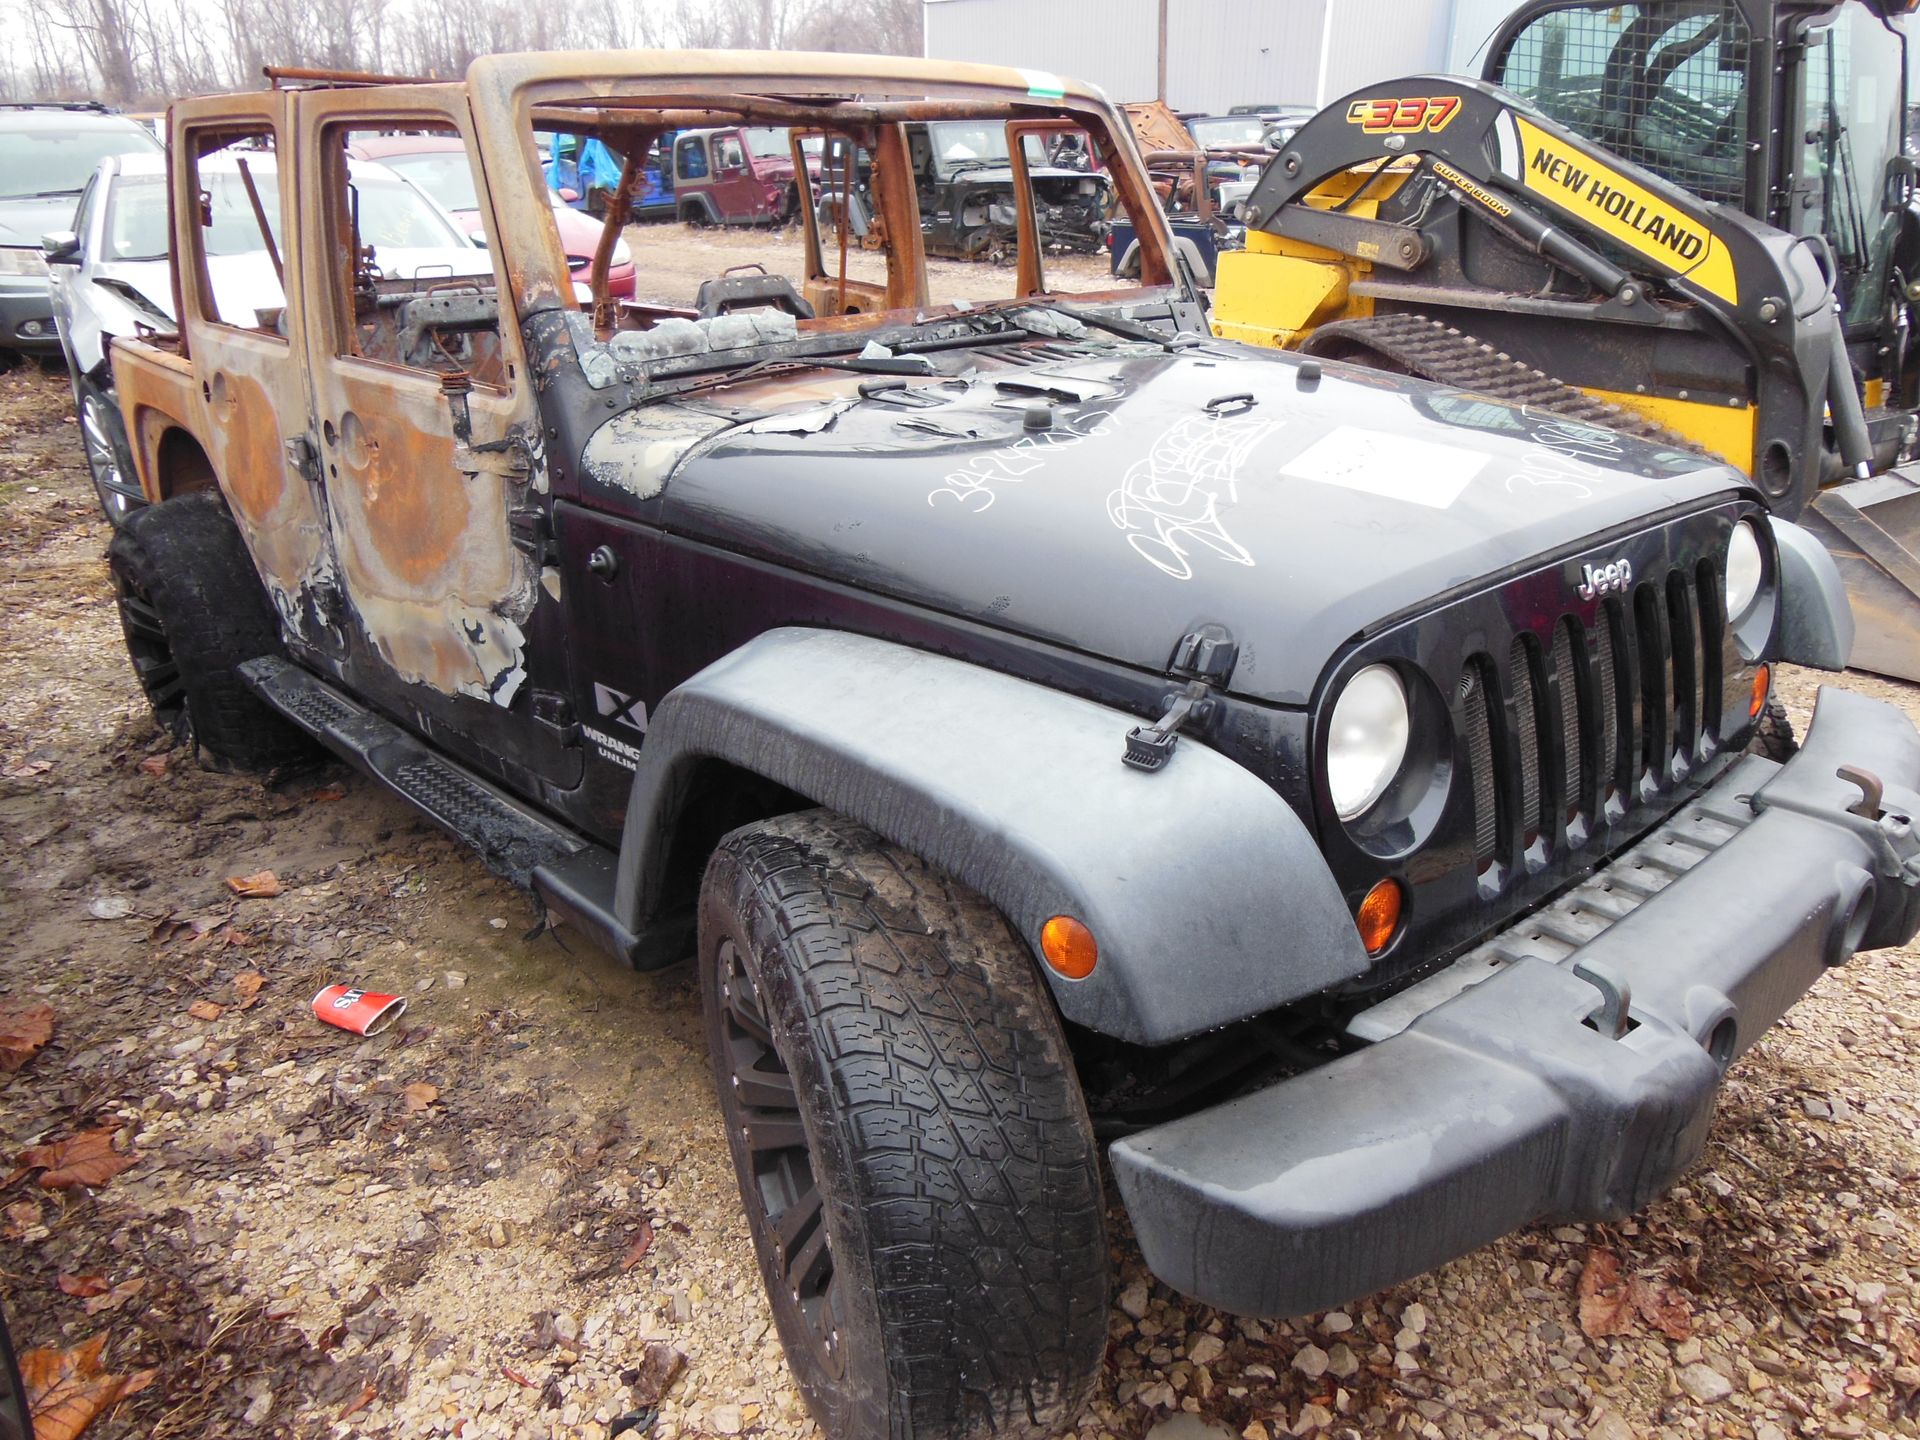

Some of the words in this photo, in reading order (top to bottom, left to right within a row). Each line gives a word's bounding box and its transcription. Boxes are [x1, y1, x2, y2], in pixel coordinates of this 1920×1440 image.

[1347, 96, 1461, 133] C337
[1531, 147, 1589, 194] NEW
[1586, 180, 1703, 260] HOLLAND
[1577, 558, 1632, 601] Jeep
